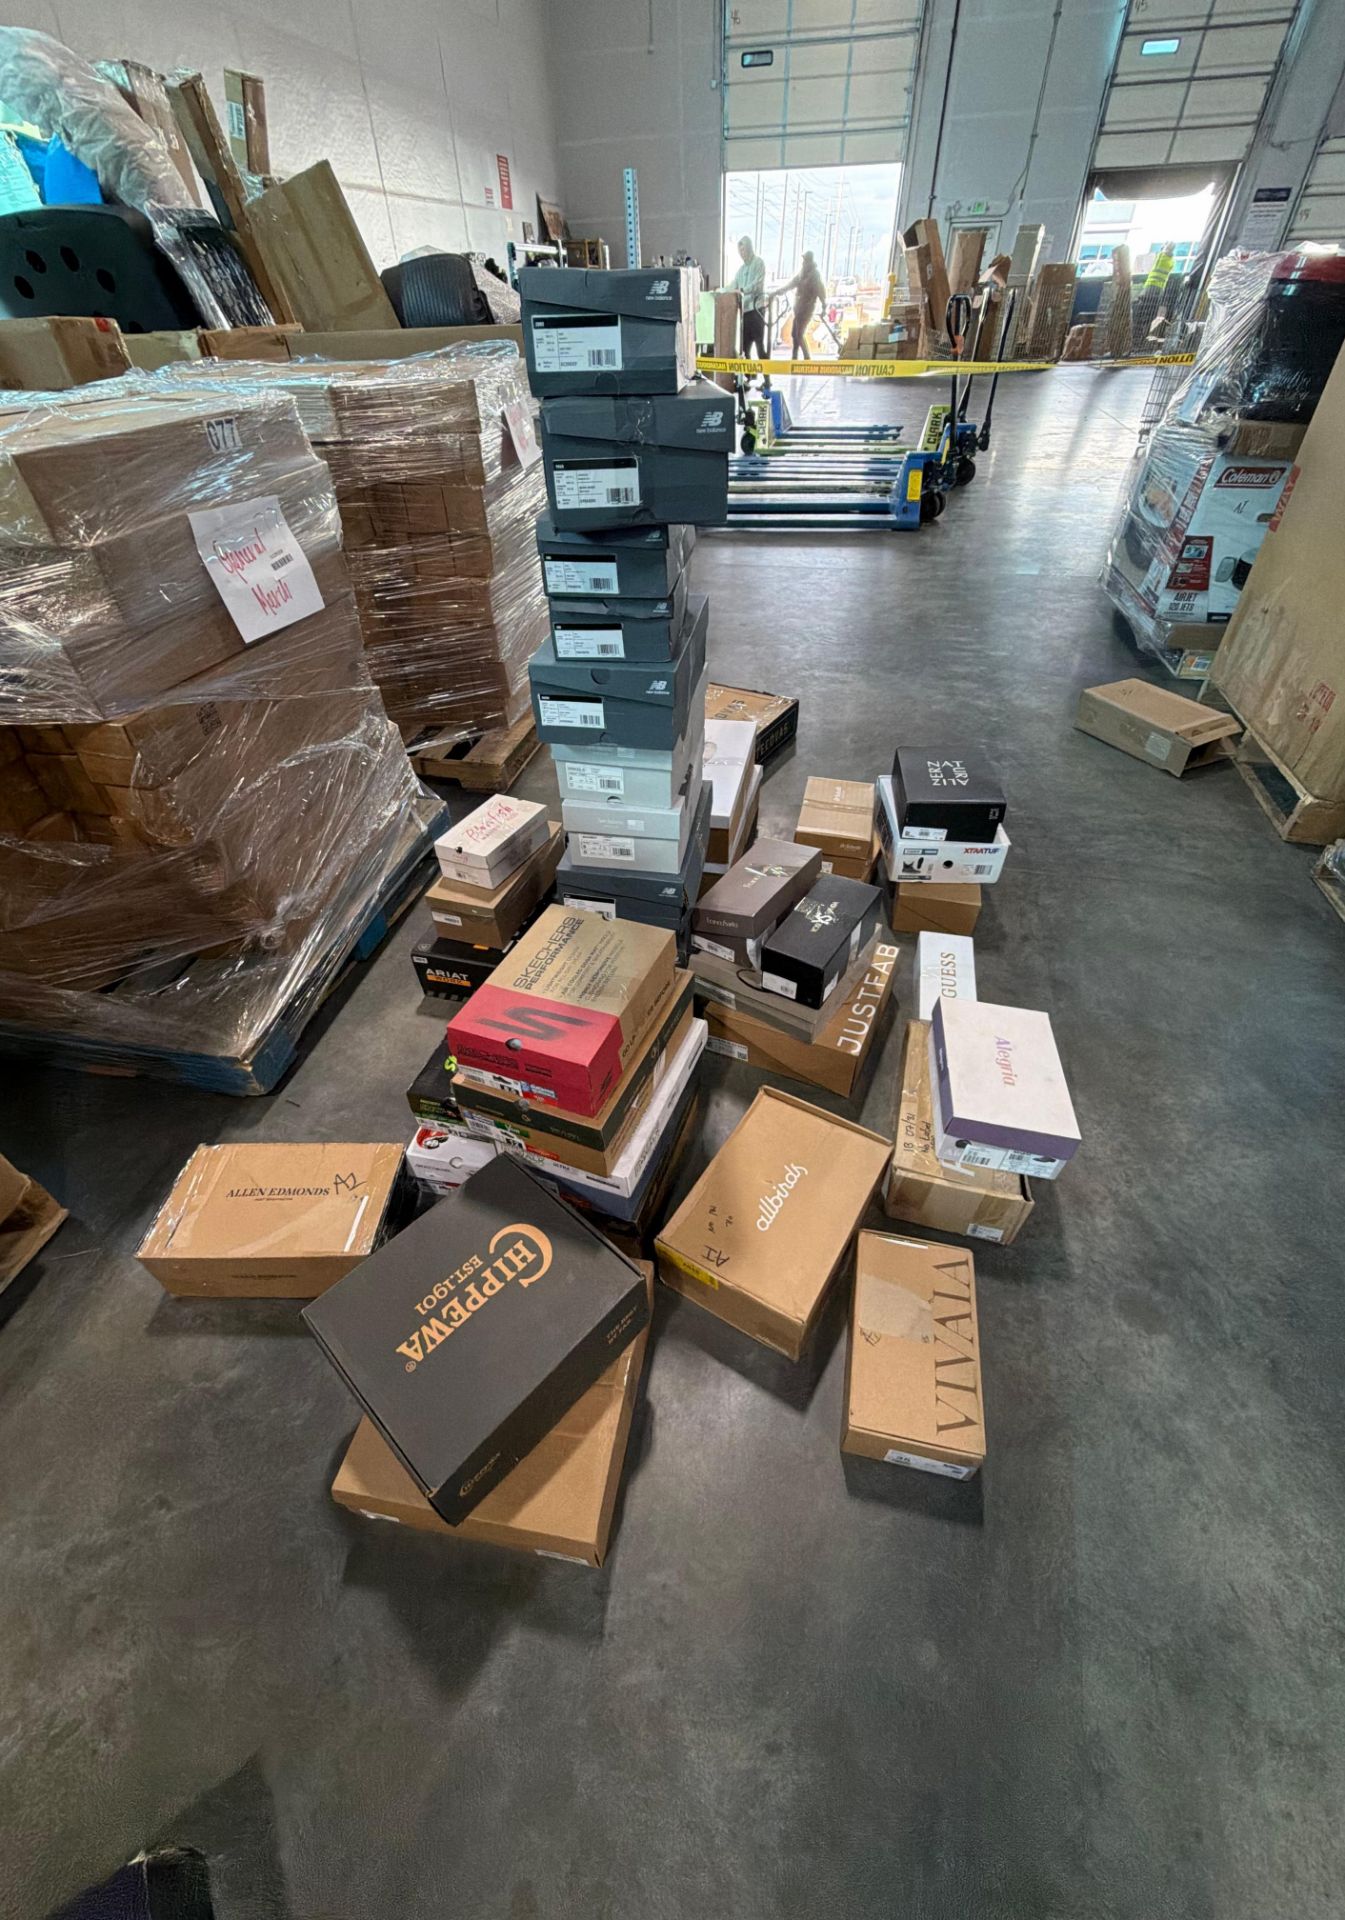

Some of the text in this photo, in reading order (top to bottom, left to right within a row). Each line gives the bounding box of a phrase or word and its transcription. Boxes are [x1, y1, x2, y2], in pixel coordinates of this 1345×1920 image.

[927, 410, 942, 444] CLARK
[1221, 468, 1268, 483] Coleman
[964, 847, 1000, 855] XTRATUF
[426, 968, 468, 981] ARIAT
[513, 916, 577, 989] SKECHERS
[525, 919, 584, 990] PERFORMANCE
[940, 951, 958, 999] GUESS
[837, 943, 901, 1057] JUSTFAB
[994, 1036, 1018, 1087] Alegria
[226, 1187, 330, 1198] ALLEN EDMONDS
[756, 1163, 808, 1231] allbirds
[396, 1223, 553, 1362] CHIPPEWA
[931, 1257, 980, 1436] VIVAIA
